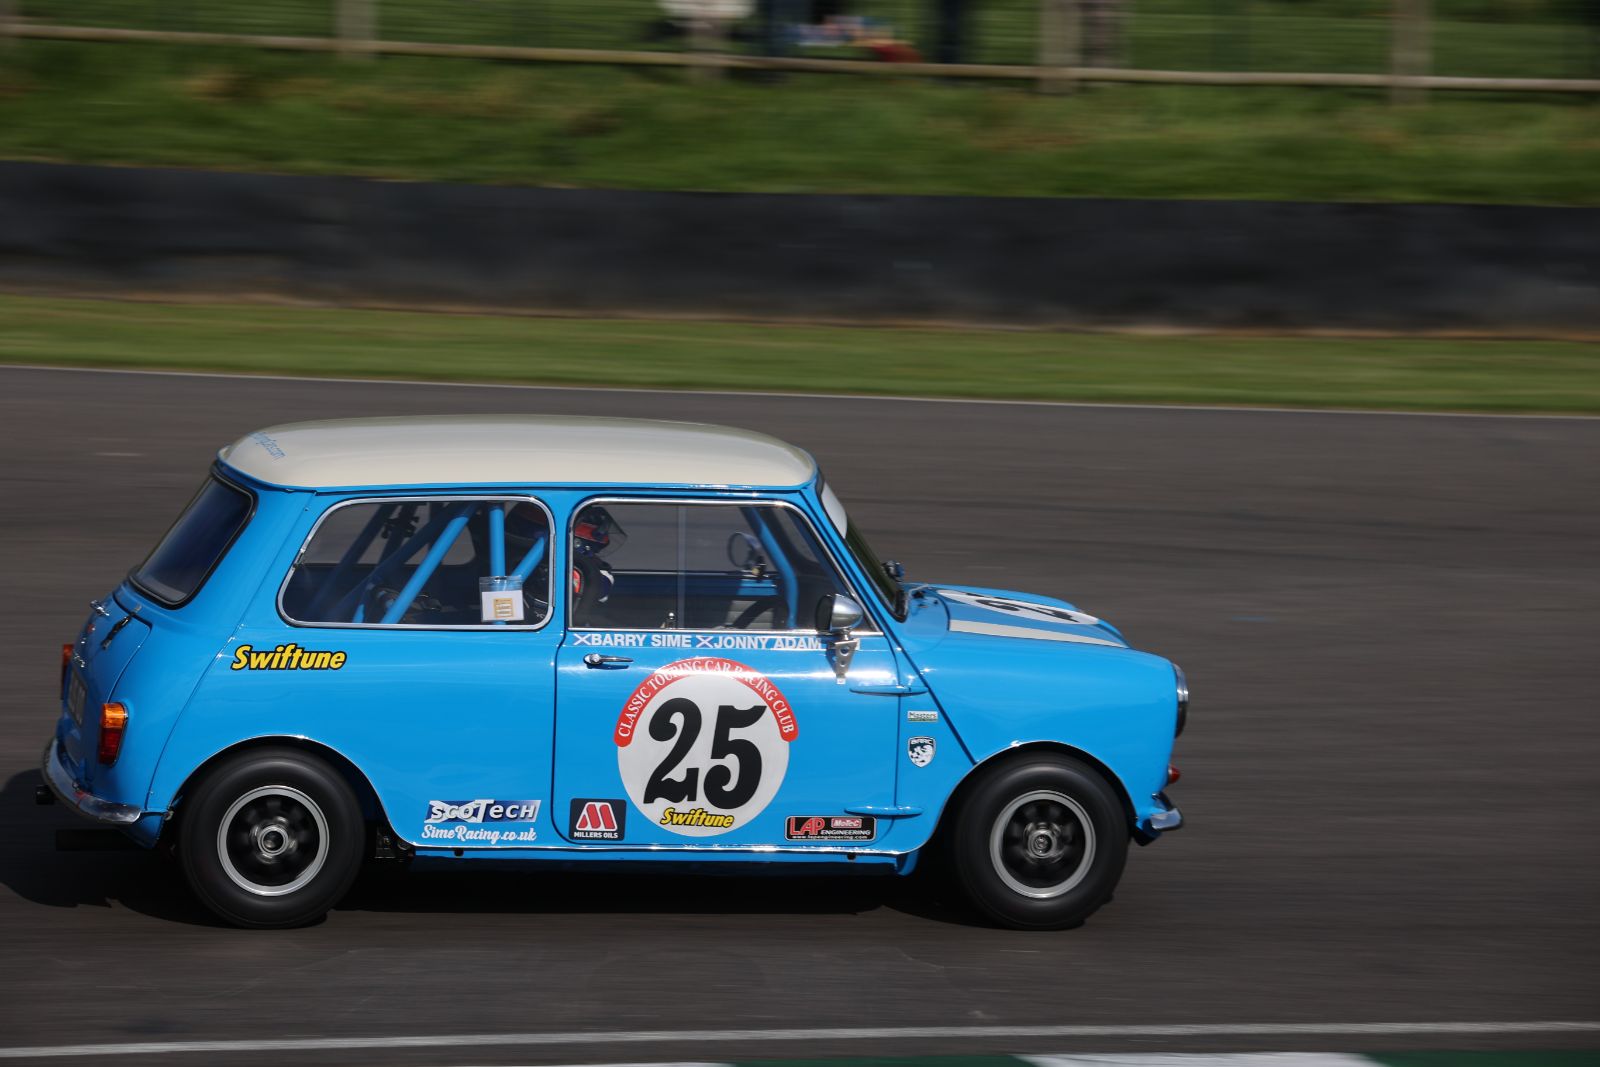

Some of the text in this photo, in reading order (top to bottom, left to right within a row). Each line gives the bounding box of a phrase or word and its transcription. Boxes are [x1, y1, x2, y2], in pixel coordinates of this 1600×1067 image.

[591, 633, 822, 650] BARRY SIME JONNY ADAM
[230, 643, 347, 671] Swiftune
[618, 686, 651, 737] CLASSIC
[704, 660, 731, 673] CAR
[734, 665, 778, 701] RCING
[772, 699, 795, 733] CLUB
[643, 697, 767, 810] 25
[660, 807, 735, 828] Swiftune
[789, 816, 826, 836] LAP
[421, 824, 537, 845] SimeRacing.co.uk
